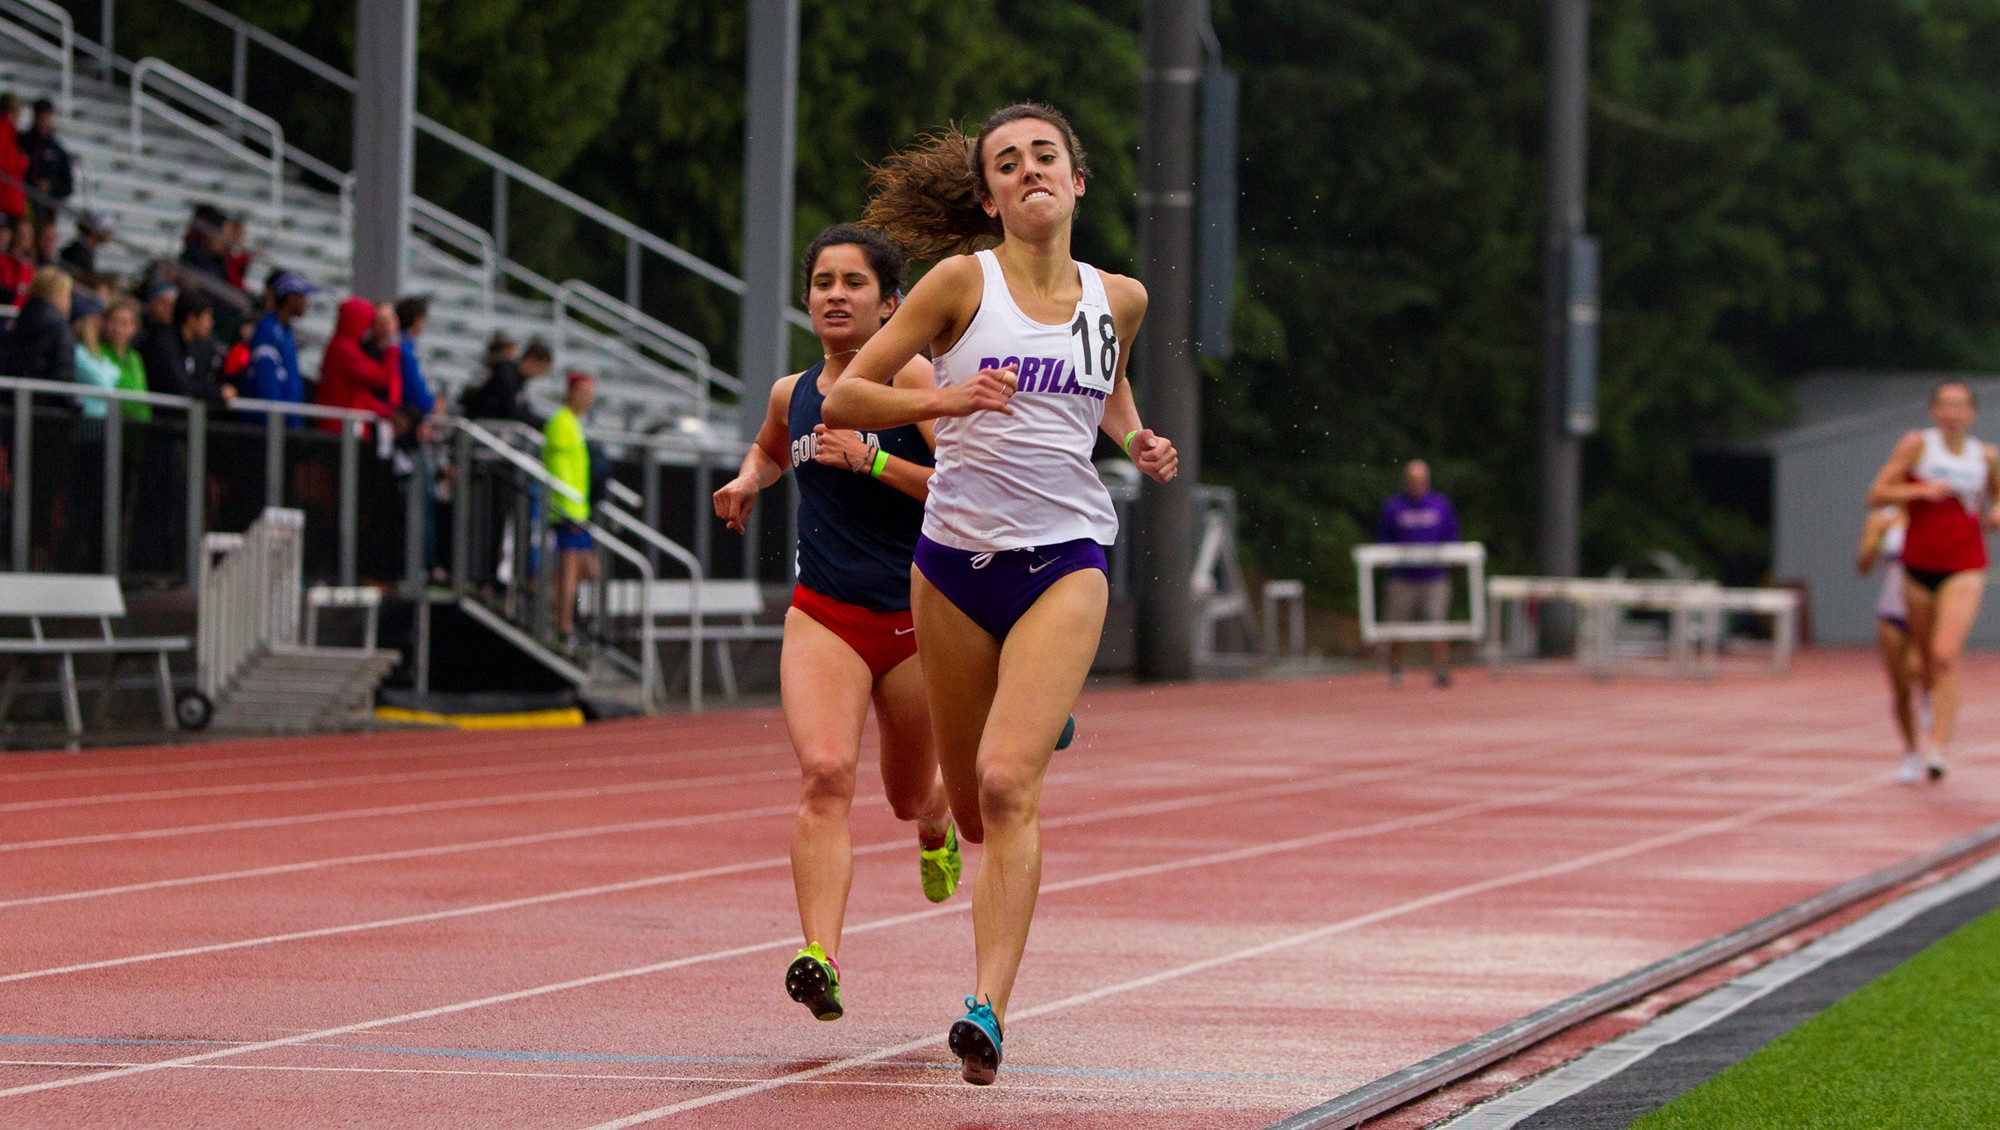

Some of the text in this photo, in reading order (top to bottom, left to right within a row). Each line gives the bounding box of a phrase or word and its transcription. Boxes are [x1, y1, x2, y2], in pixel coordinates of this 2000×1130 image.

[1072, 311, 1116, 381] 18
[979, 356, 1105, 400] ORTLA
[791, 431, 881, 468] GONA
